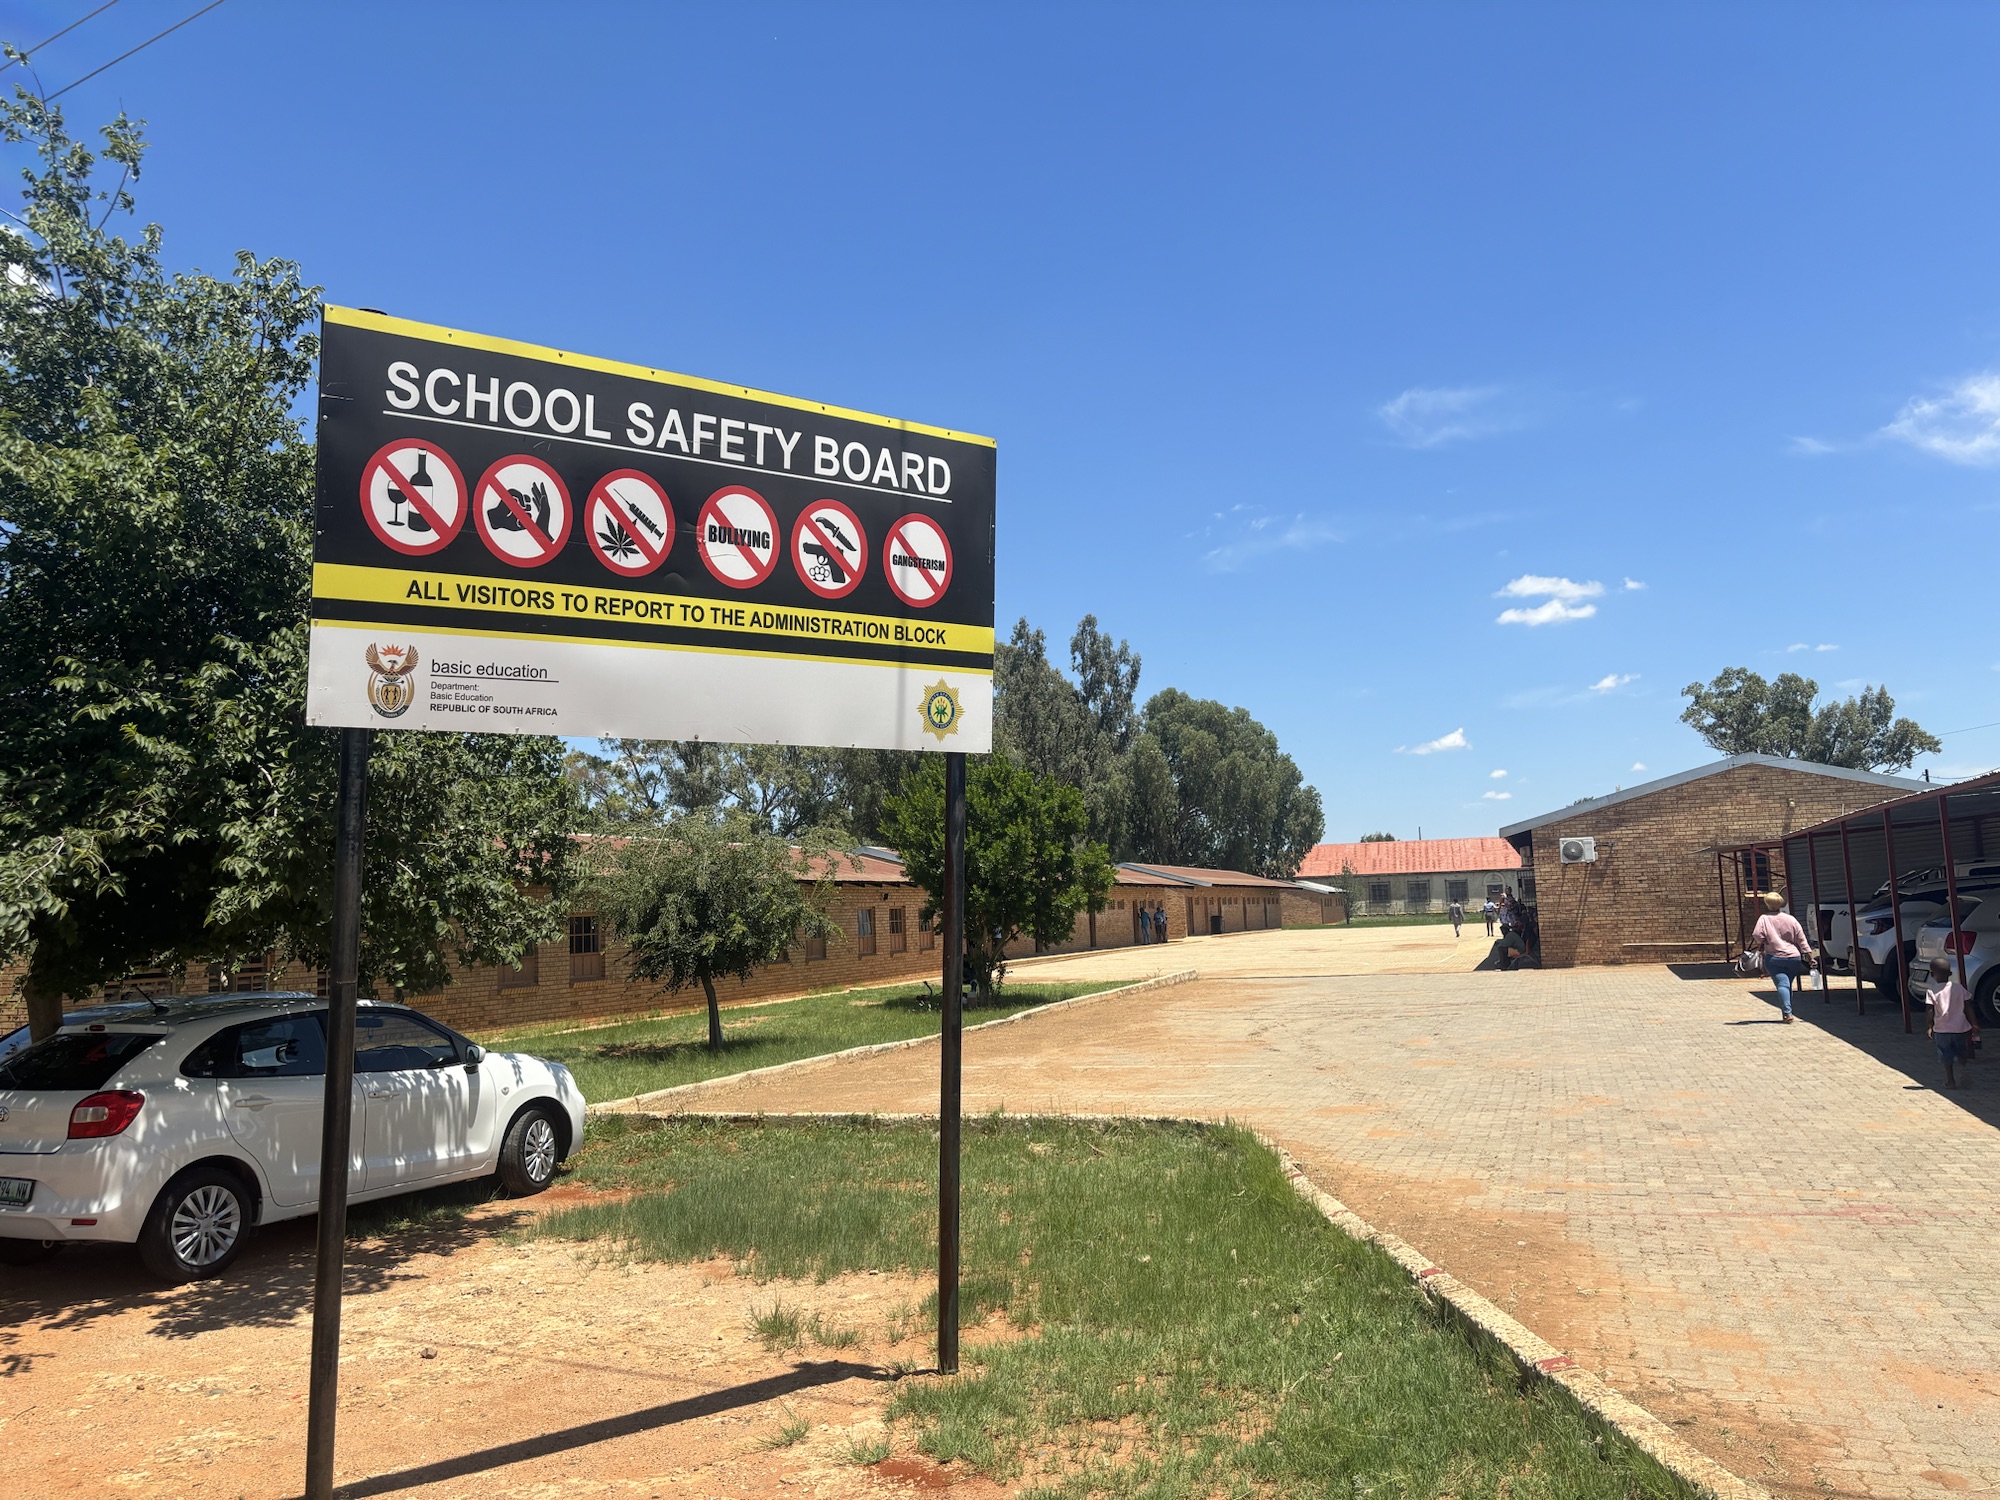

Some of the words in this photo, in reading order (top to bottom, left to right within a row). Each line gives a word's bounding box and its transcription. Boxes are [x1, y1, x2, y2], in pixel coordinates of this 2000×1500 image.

[385, 361, 611, 440] SCHOOL
[626, 402, 802, 470] SAFETY
[814, 435, 951, 495] BOARD
[708, 524, 770, 549] BULLYING
[892, 554, 945, 572] GANGSTERISM
[406, 580, 450, 601] ALL
[456, 583, 555, 609] VISITORS
[561, 593, 588, 612] TO
[595, 596, 674, 619] REPORT
[680, 604, 704, 622] TO
[710, 607, 745, 627] THE
[750, 611, 889, 639] ADMINISTRATION
[894, 625, 946, 644] BLOCK
[431, 659, 471, 674] basic
[476, 662, 547, 679] education
[430, 681, 479, 691] Department:
[430, 692, 452, 700] Basic
[454, 693, 494, 702] Education
[430, 703, 476, 713] REPUBLIC
[478, 705, 491, 713] OF
[493, 706, 523, 715] SOUTH
[525, 707, 558, 716] AFRICA
